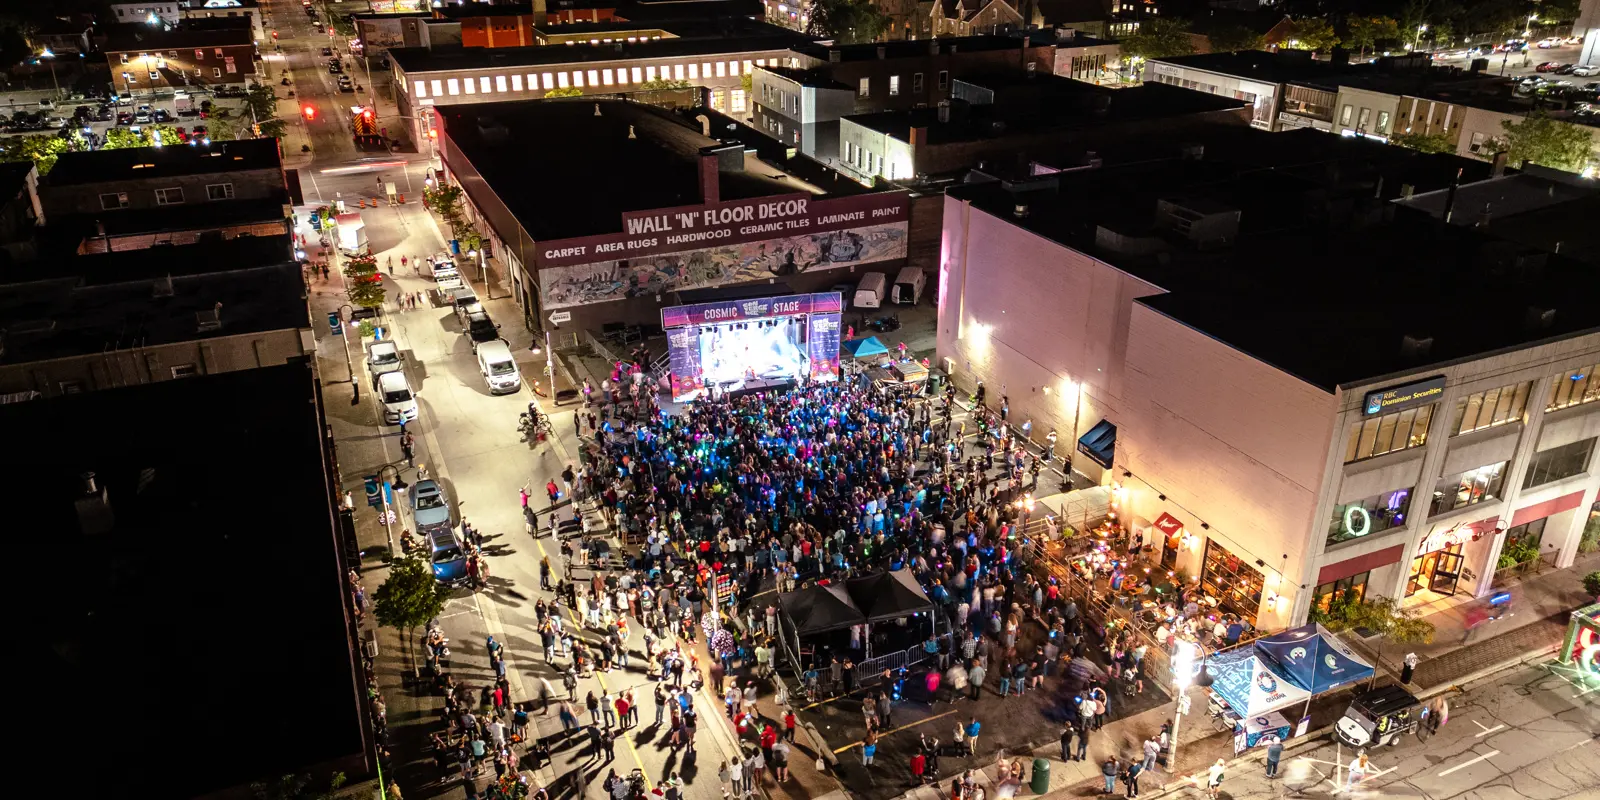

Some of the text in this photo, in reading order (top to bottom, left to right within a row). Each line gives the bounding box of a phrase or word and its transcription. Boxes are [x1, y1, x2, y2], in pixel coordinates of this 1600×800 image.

[627, 198, 807, 235] WALL "N" FLOOR DECOR
[545, 206, 901, 259] CARPET AREA RUGS HARDWOOD CERAMIC TILES LAMINATE PAINT
[704, 301, 799, 320] COSMIC STAGE
[1382, 387, 1442, 406] Dominion Securities
[1383, 391, 1397, 399] RBC
